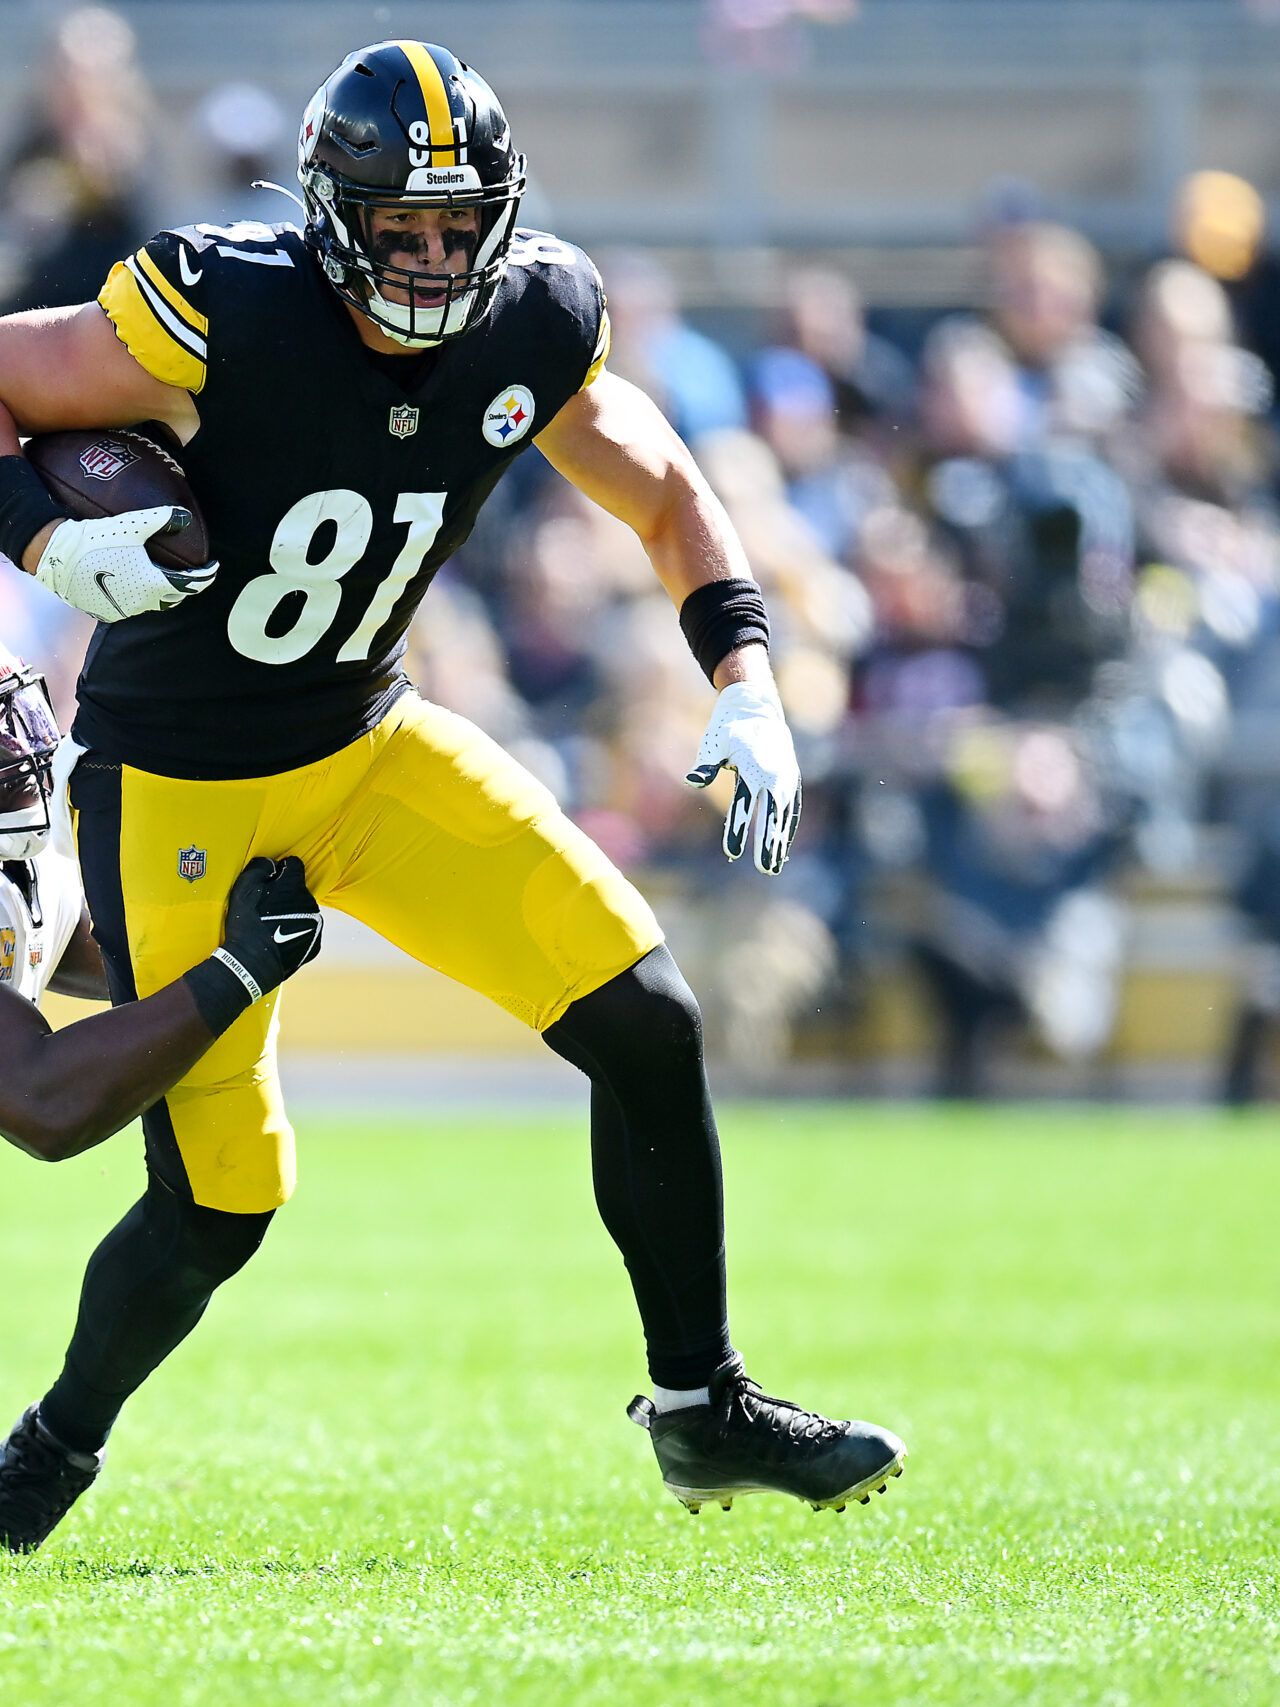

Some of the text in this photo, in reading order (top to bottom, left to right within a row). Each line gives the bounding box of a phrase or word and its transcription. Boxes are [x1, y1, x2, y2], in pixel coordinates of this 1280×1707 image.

[408, 117, 468, 168] 81
[426, 171, 465, 185] Steelers
[394, 418, 414, 432] NFL
[81, 447, 119, 475] NFL
[227, 489, 448, 665] 81
[182, 861, 202, 876] NFL
